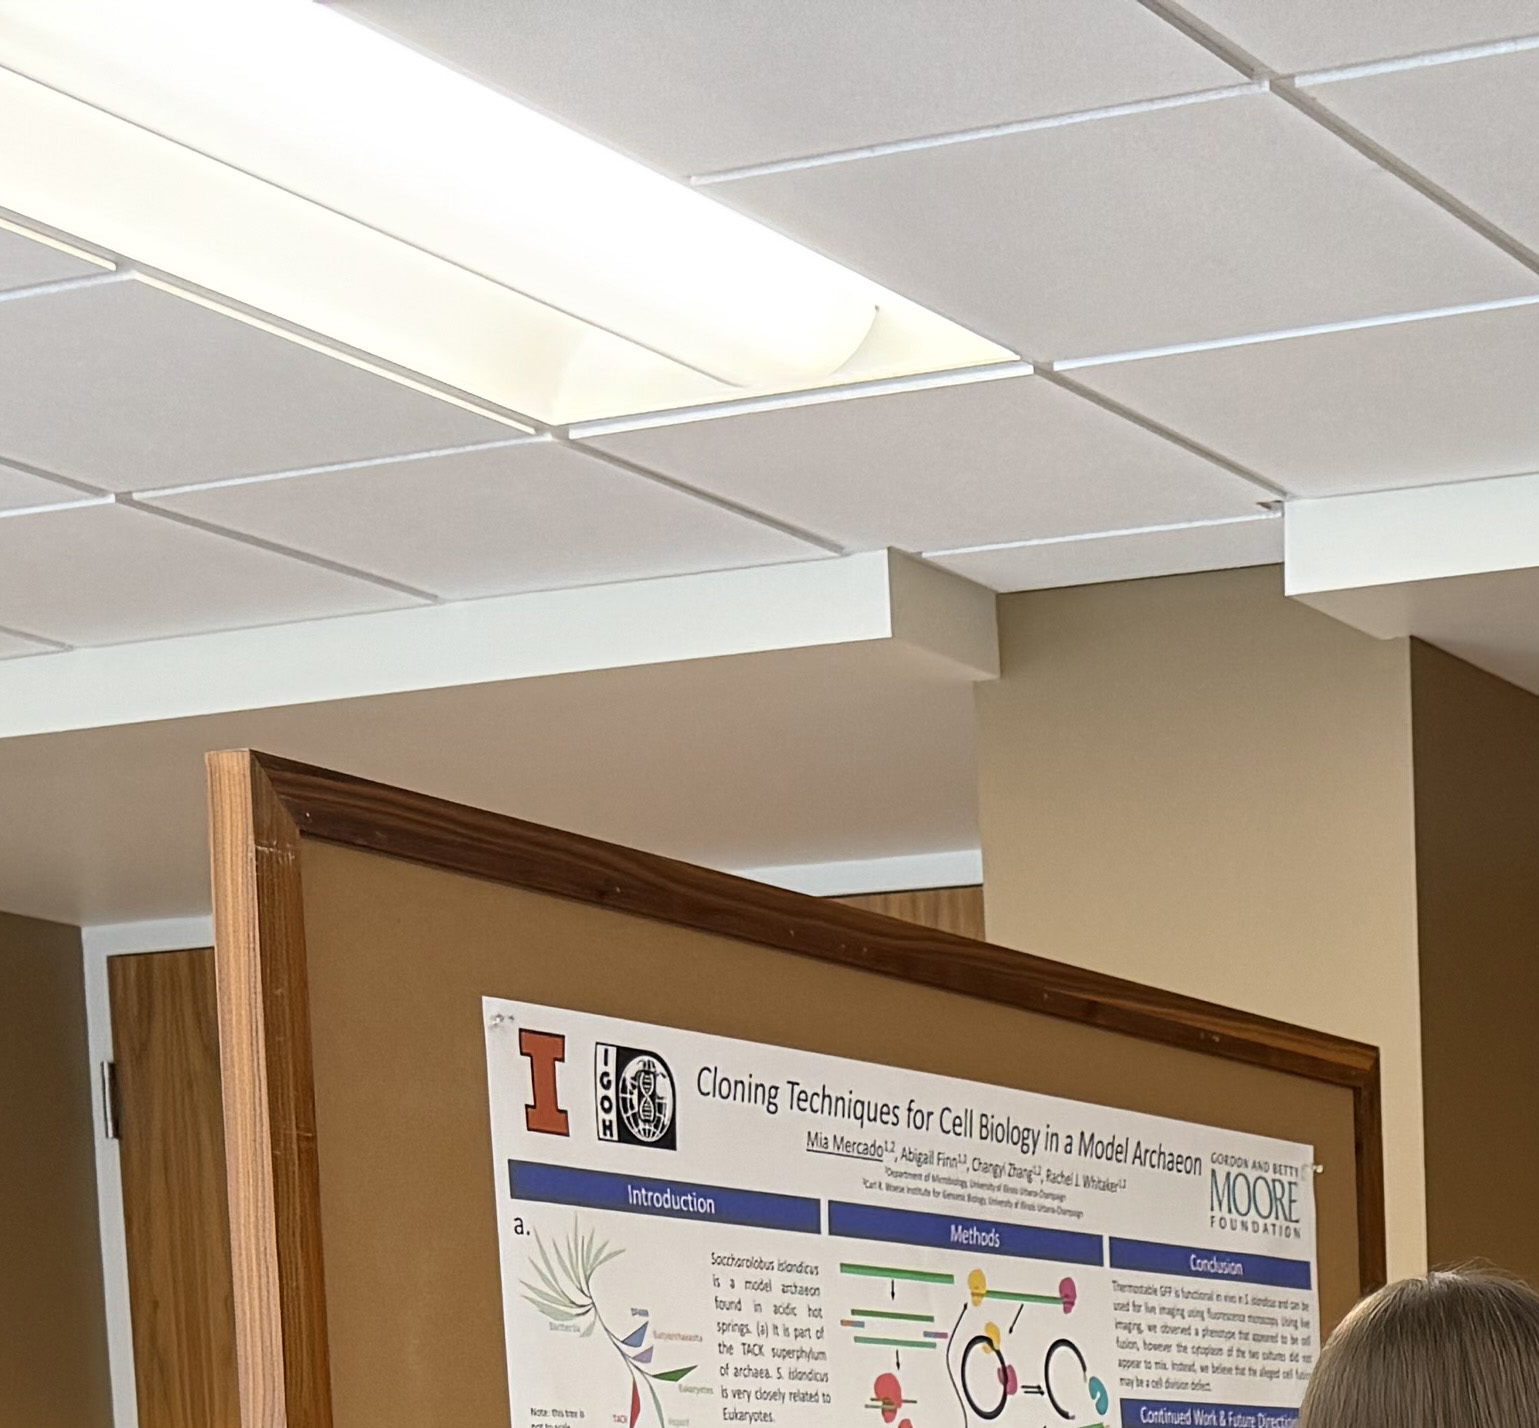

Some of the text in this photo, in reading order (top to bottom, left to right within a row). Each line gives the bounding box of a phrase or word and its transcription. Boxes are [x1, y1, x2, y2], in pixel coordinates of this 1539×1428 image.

[697, 1066, 1202, 1176] Cloning Techniques for Cell Biology in a Model Archaeon
[807, 1131, 829, 1150] Mia
[900, 1146, 935, 1167] Abigail
[1210, 1152, 1298, 1178] GORDON AND BETTY
[628, 1183, 716, 1214] Introduction
[1210, 1168, 1300, 1223] MOORE
[513, 1215, 531, 1236] a.
[950, 1223, 1001, 1249] Methods
[1210, 1215, 1301, 1239] FOUNDATION
[1190, 1253, 1244, 1276] Conclusion
[1140, 1406, 1191, 1425] Continued
[1193, 1409, 1218, 1426] Work
[1219, 1410, 1227, 1427] &
[1228, 1411, 1256, 1428] Future
